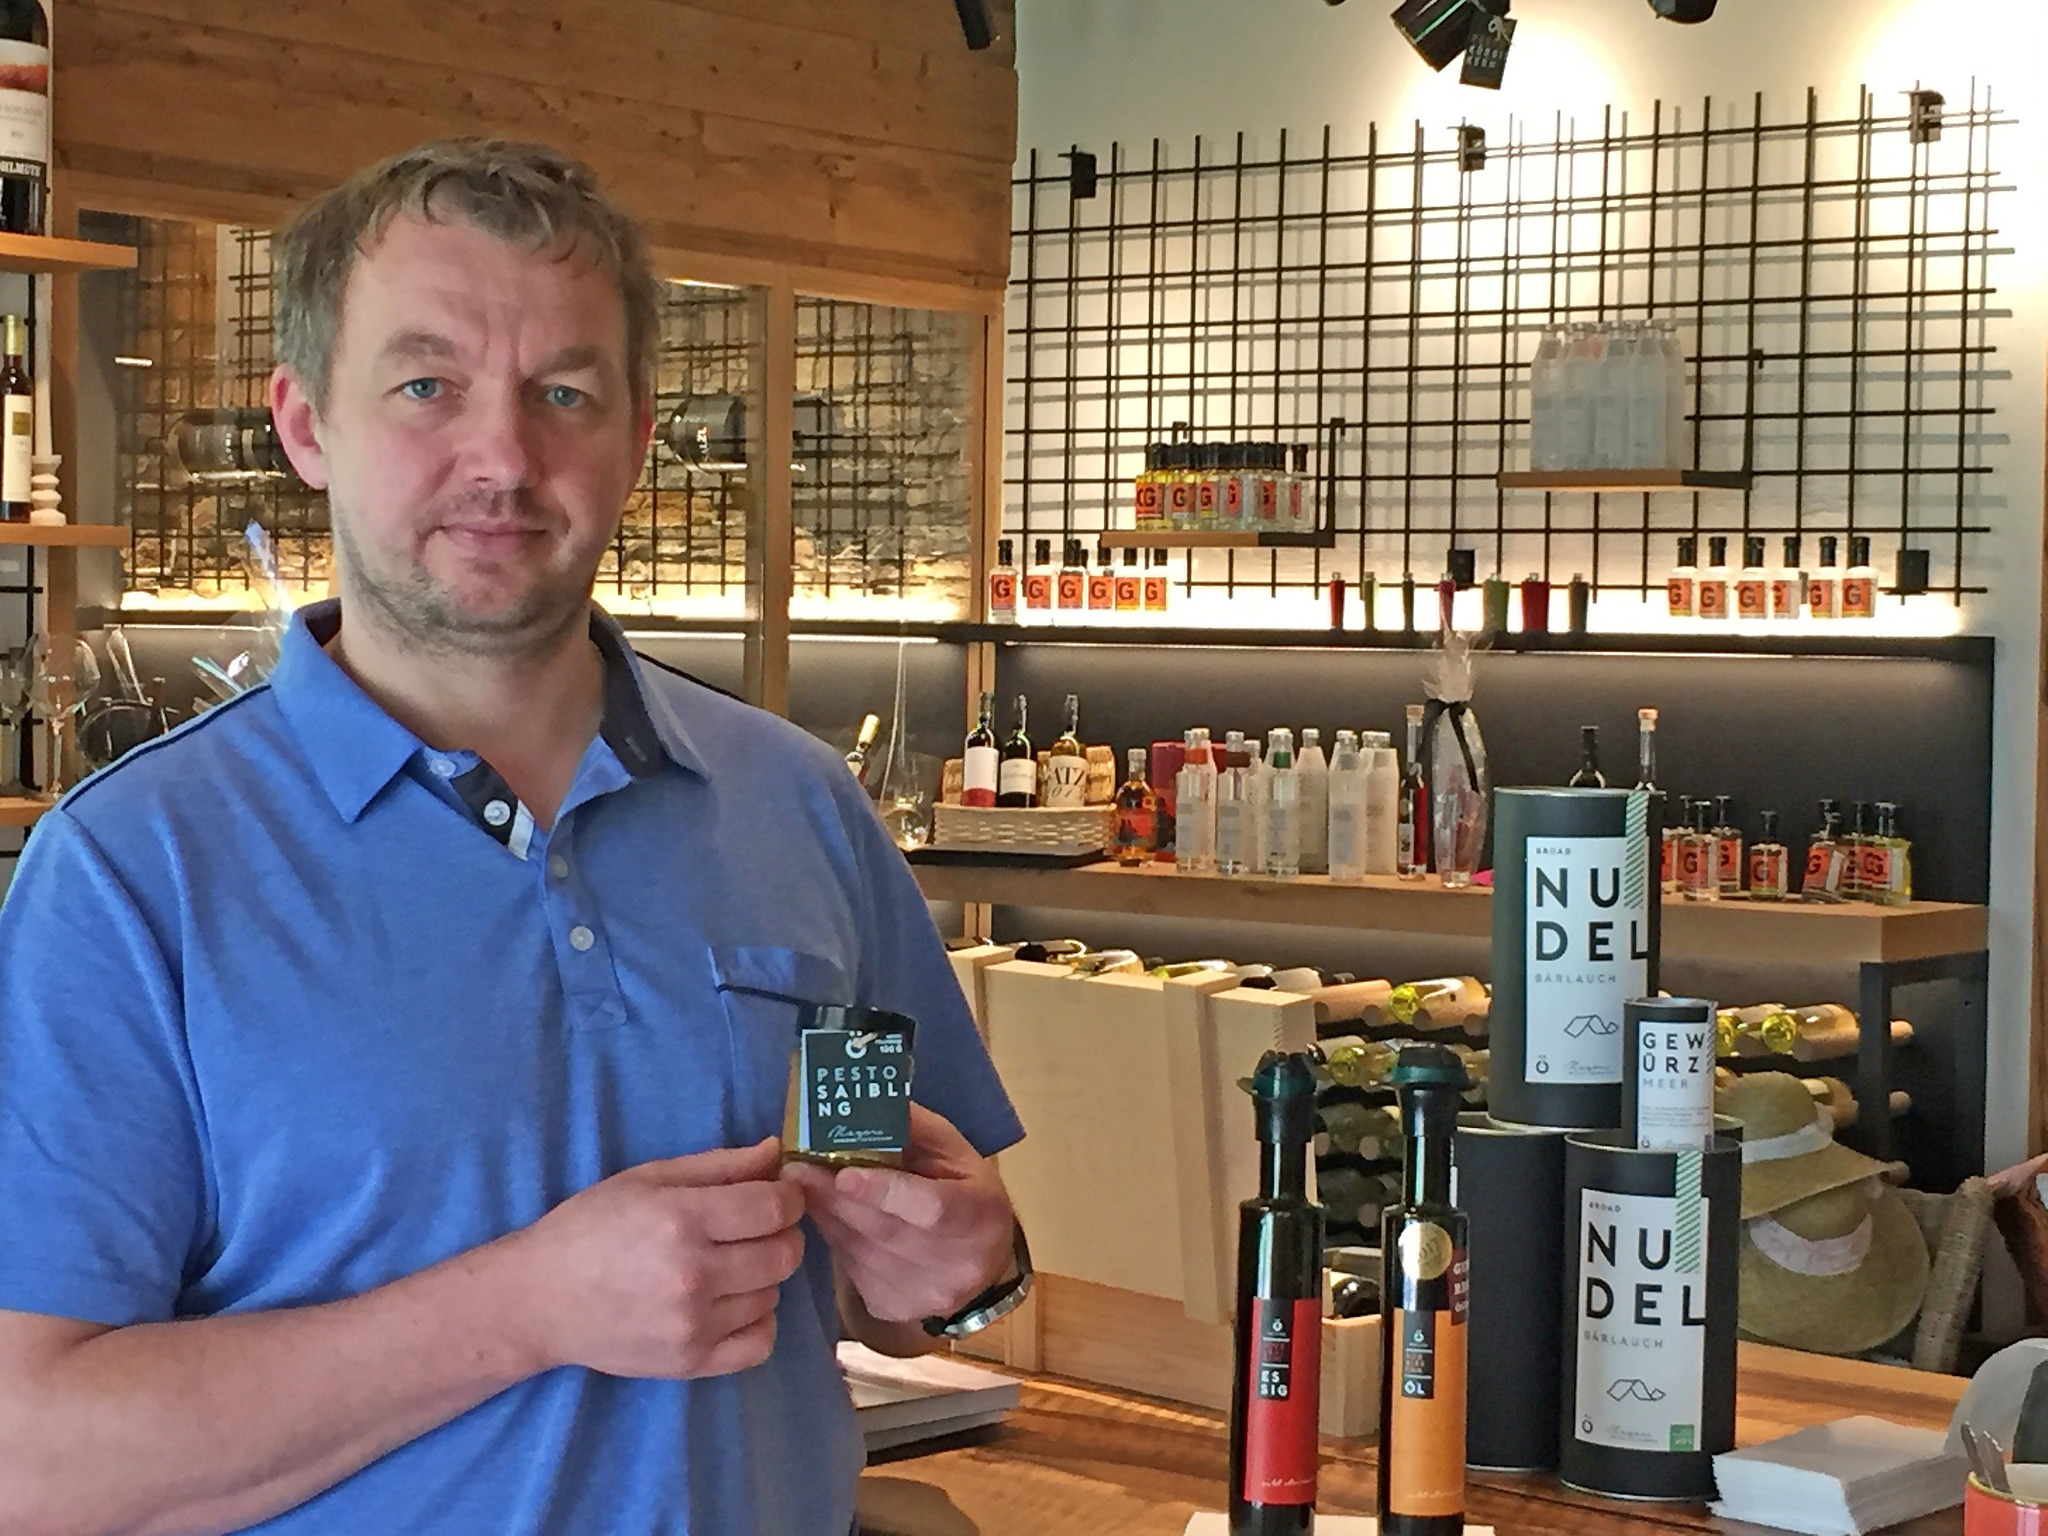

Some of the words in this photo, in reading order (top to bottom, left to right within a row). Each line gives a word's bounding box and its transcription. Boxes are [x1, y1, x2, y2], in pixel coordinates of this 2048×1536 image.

[1173, 488, 1185, 507] G
[996, 579, 1010, 598] G
[1029, 580, 1043, 598] G
[1061, 580, 1076, 598] G
[1091, 581, 1106, 599] G
[1119, 582, 1134, 601] G
[1145, 582, 1157, 601] G
[1668, 584, 1681, 604] G
[1701, 586, 1715, 607] G
[1739, 586, 1756, 607] G
[1810, 585, 1821, 606] G
[1844, 584, 1861, 605] G
[1684, 852, 1698, 873] G
[1536, 868, 1620, 908] NU
[1536, 921, 1648, 961] DEL
[1643, 1032, 1705, 1050] GEW
[1643, 1053, 1699, 1073] ÜRZ
[817, 1065, 897, 1082] PESTO
[817, 1082, 911, 1100] SAIBLI
[1643, 1078, 1688, 1089] MEER
[818, 1102, 851, 1117] NG
[1588, 1221, 1671, 1270] NU
[1586, 1277, 1707, 1326] DEL
[1261, 1370, 1280, 1383] ES
[1260, 1383, 1288, 1397] SIG
